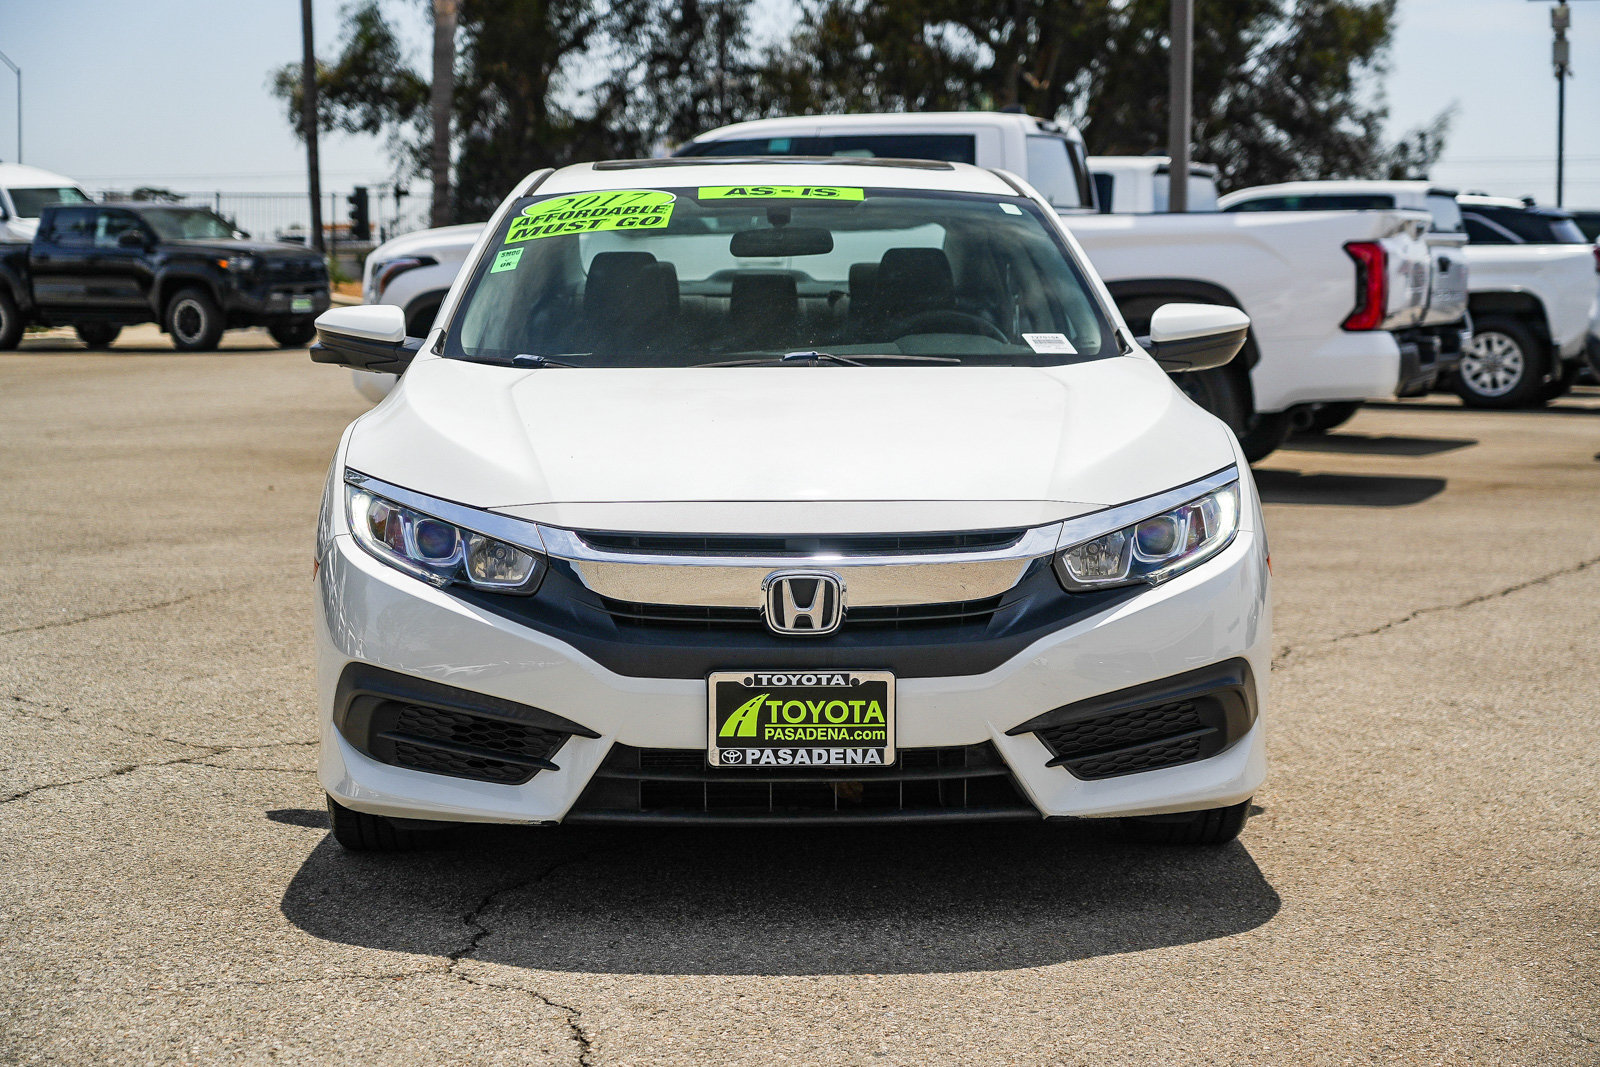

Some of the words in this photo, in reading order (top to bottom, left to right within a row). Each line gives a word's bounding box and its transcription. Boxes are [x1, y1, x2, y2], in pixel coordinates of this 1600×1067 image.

[546, 192, 653, 213] 2017
[513, 204, 672, 228] AFFORDABLE
[510, 218, 608, 240] MUST
[615, 215, 665, 227] GO
[758, 675, 846, 686] TOYOTA
[766, 700, 886, 724] TOYOTA
[764, 727, 886, 741] PASADENA.com
[746, 749, 881, 765] PASADENA
